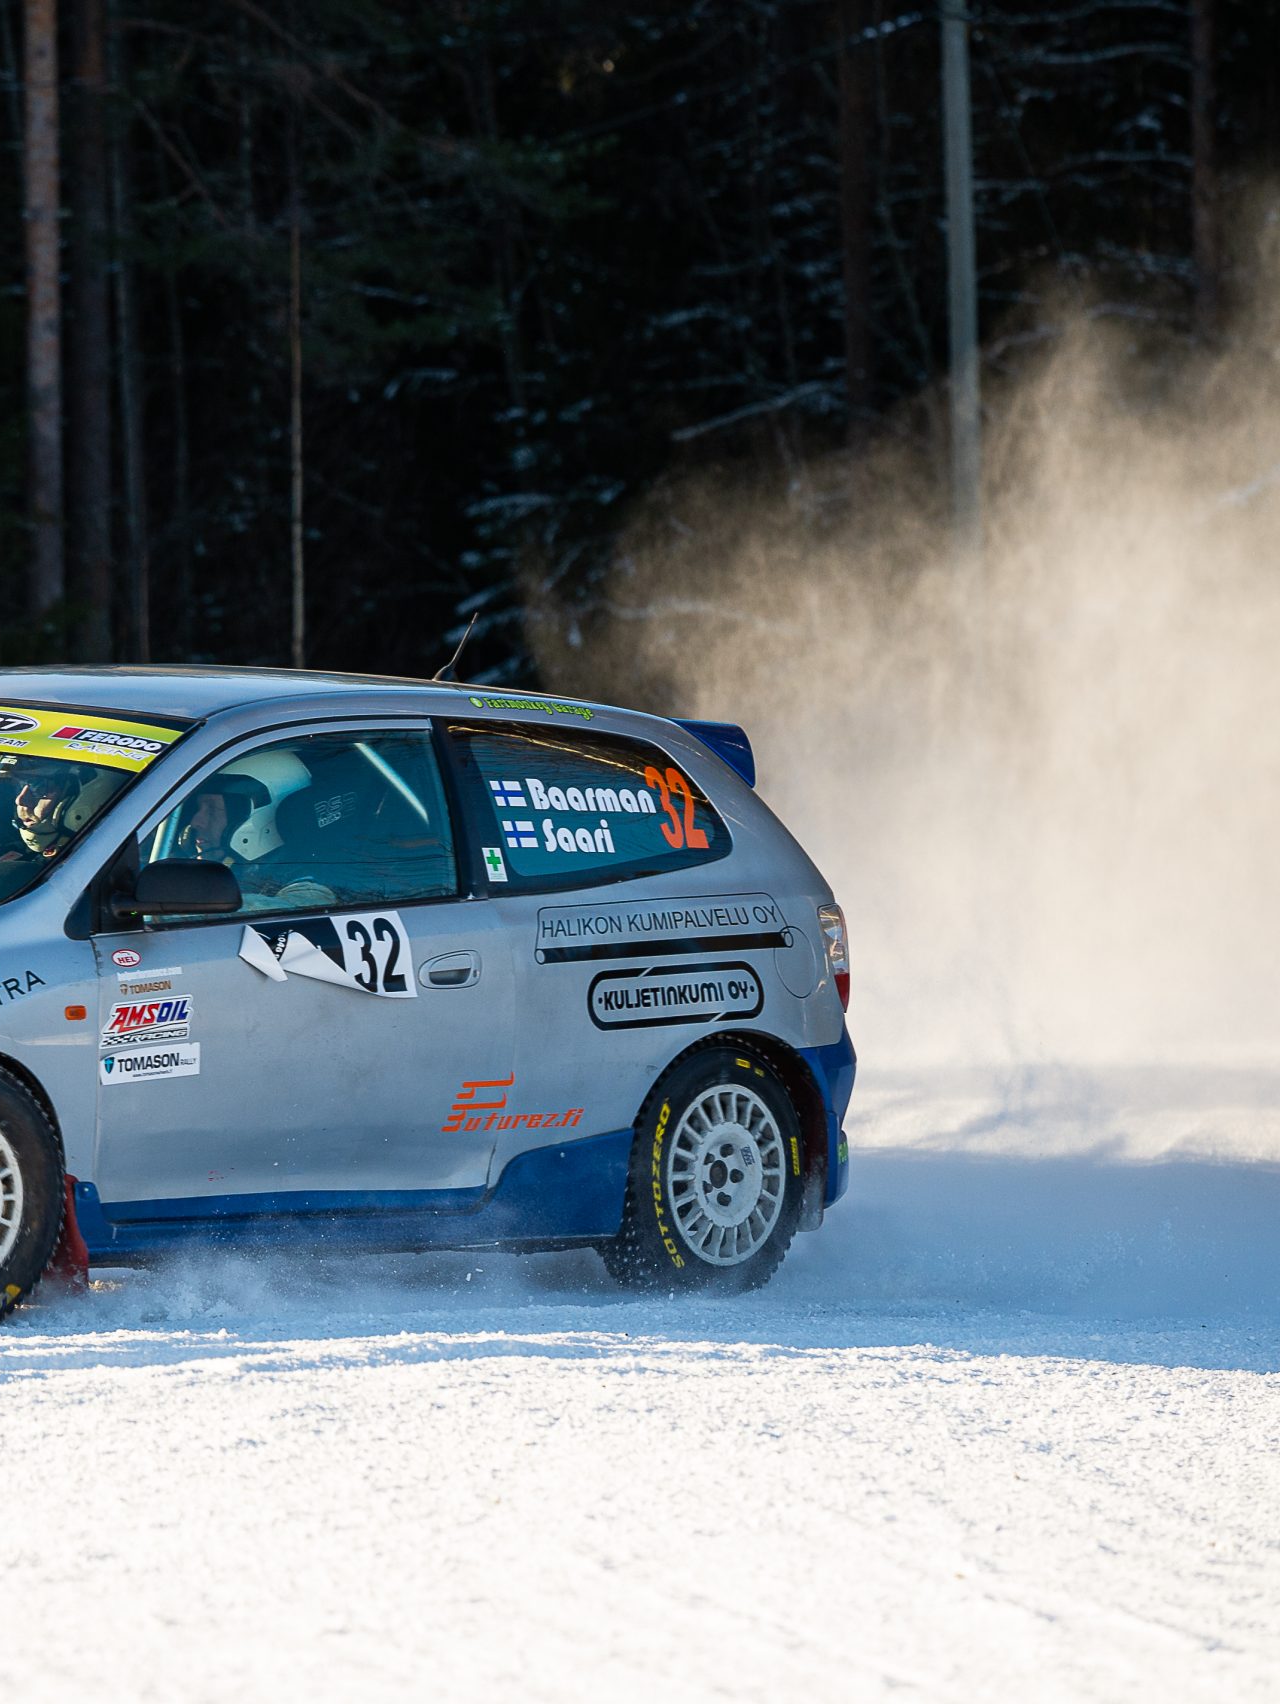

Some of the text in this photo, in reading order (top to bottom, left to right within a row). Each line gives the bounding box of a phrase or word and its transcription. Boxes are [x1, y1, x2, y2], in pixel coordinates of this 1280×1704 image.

[66, 742, 150, 762] RACING
[77, 731, 163, 752] FERODO
[525, 778, 657, 814] Baarman
[644, 765, 710, 849] 32
[541, 818, 616, 854] Saari
[541, 905, 778, 938] HALIKON KUMIPALVELU OY
[117, 955, 137, 965] HEL
[346, 917, 408, 993] 32
[129, 980, 172, 995] TOMASON
[603, 980, 748, 1011] KULJETINKUMI OY
[108, 999, 189, 1034] AMSOIL
[127, 1030, 188, 1042] RACING
[117, 1052, 180, 1073] TOMASON
